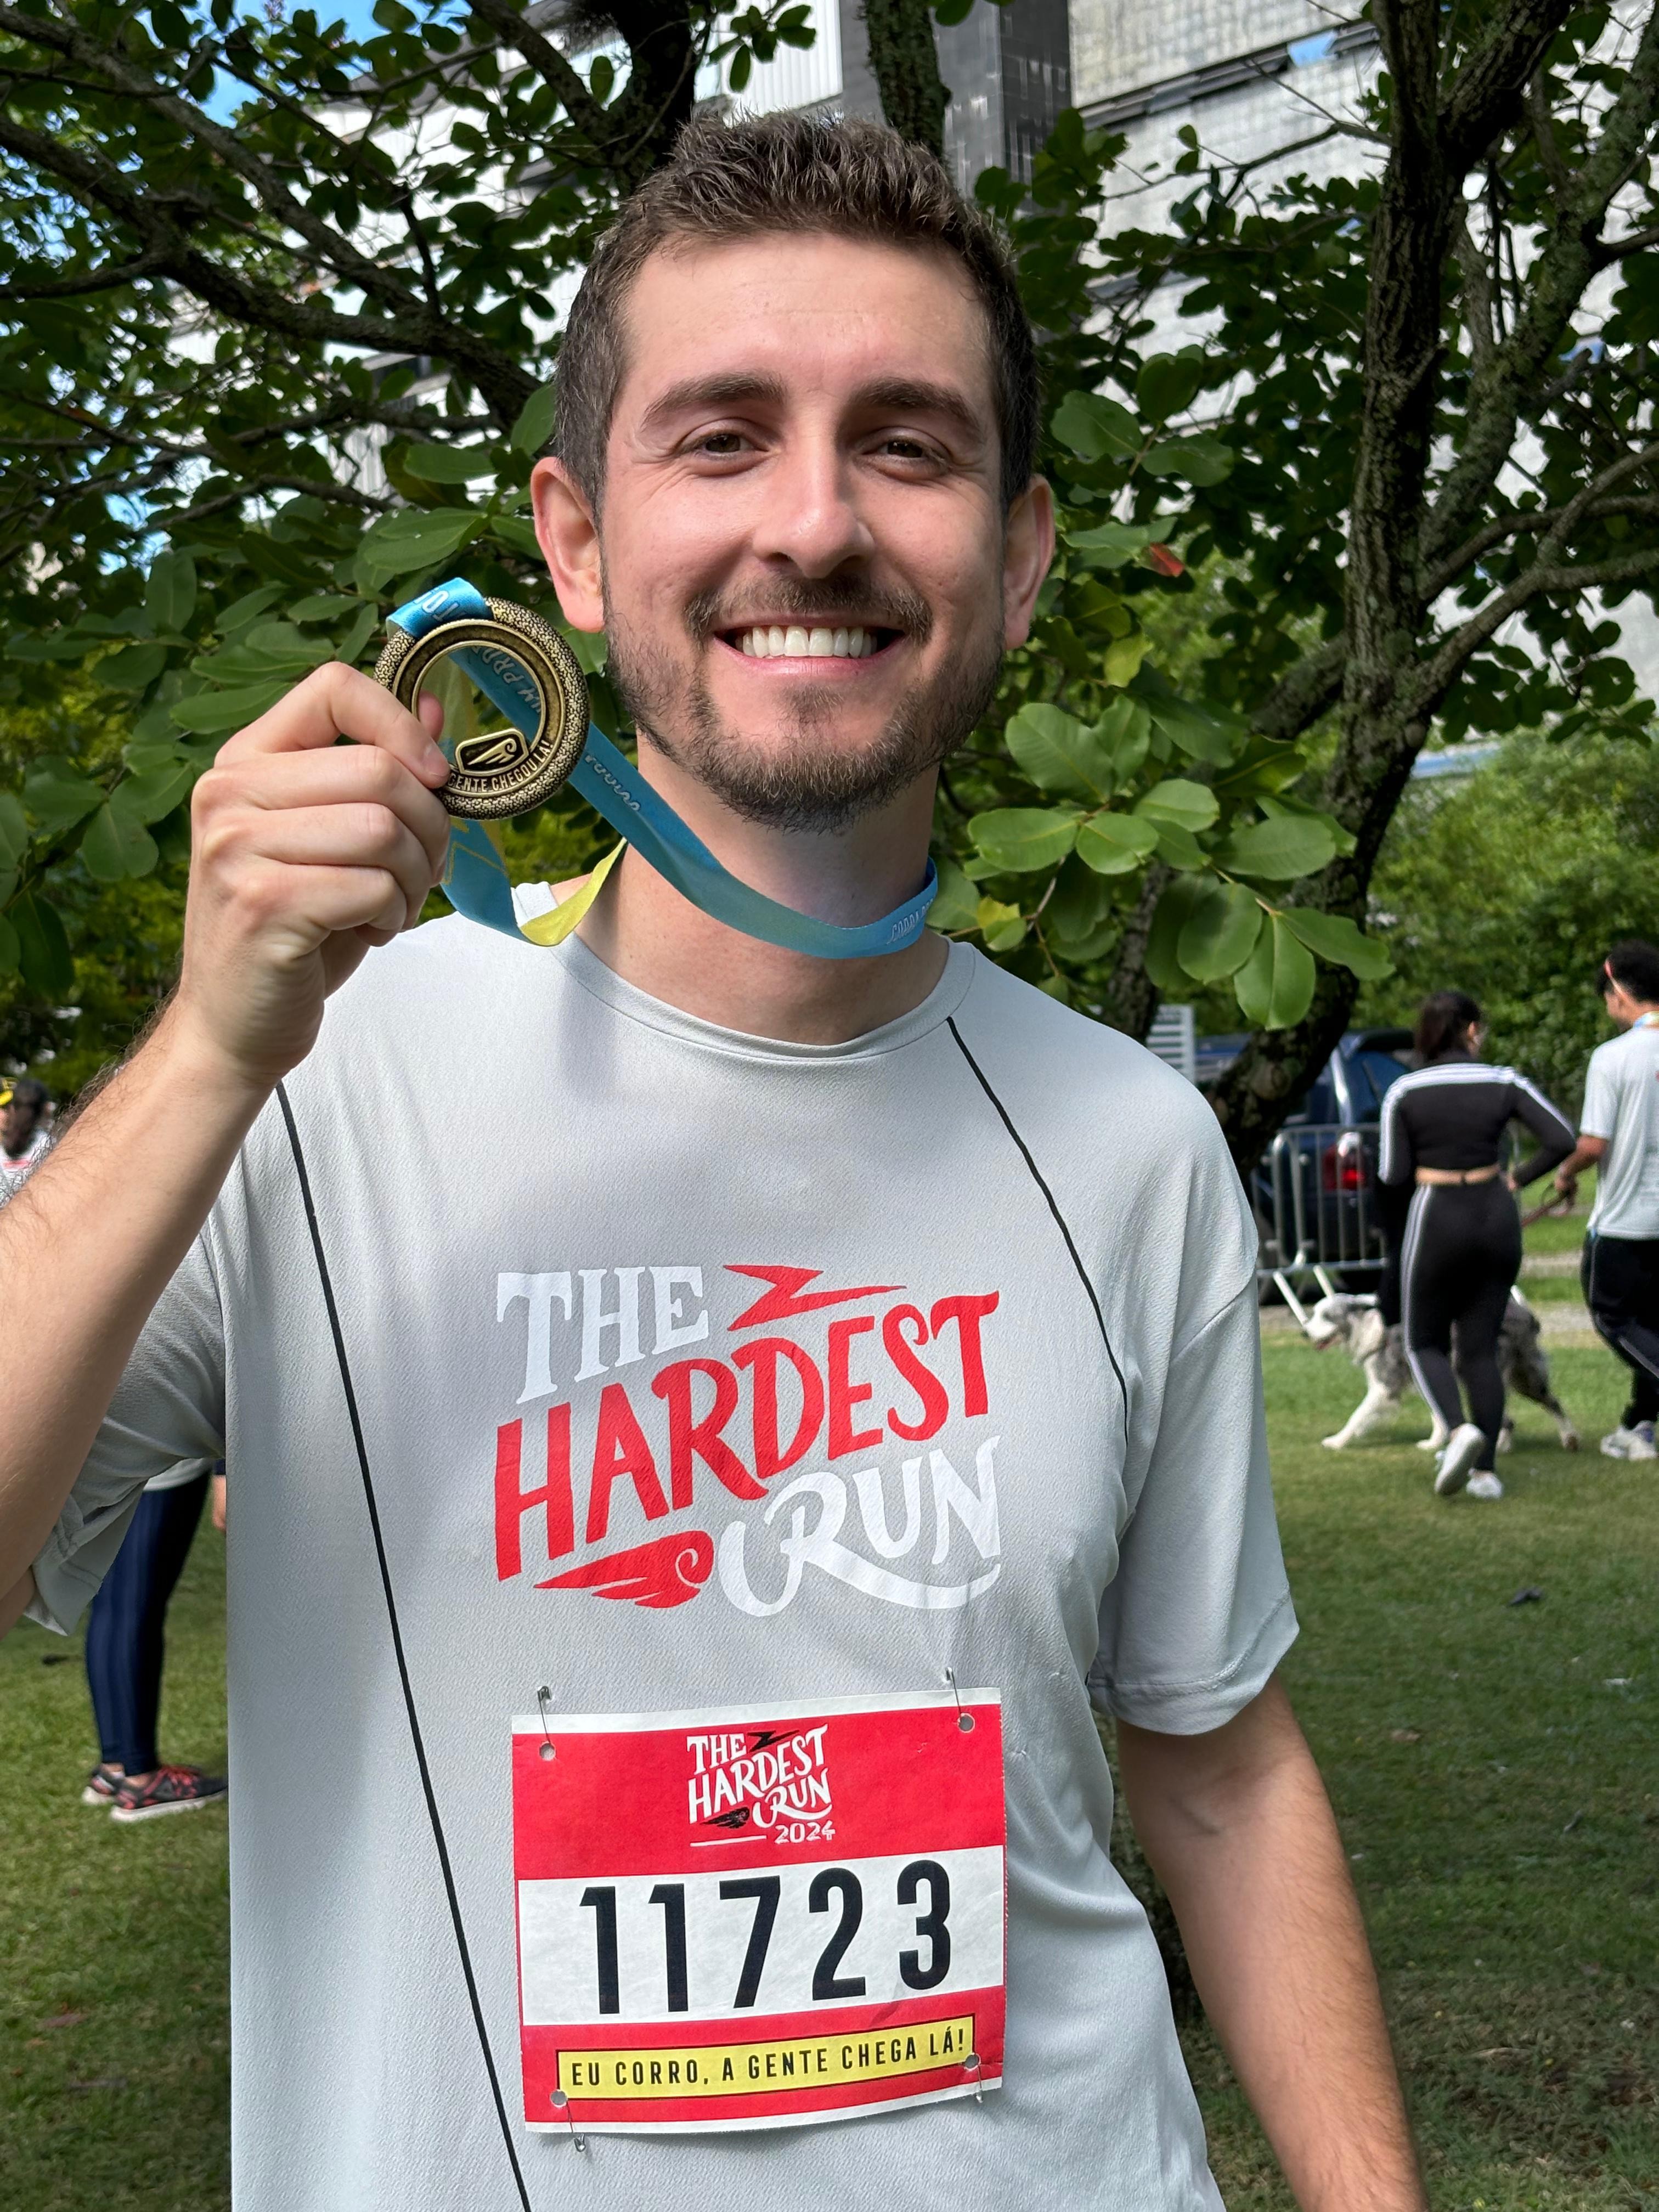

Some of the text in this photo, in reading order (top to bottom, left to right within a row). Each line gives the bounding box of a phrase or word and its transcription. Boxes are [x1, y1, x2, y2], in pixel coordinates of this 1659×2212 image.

[492, 758, 538, 790] CHEGOU
[496, 1266, 709, 1404] THE
[494, 1290, 1000, 1582] HARDEST
[718, 1435, 1002, 1617] RUN
[686, 1733, 747, 1775] THE
[687, 1723, 828, 1824] HARDEST
[752, 1768, 833, 1829] RUN
[774, 1820, 836, 1844] 2024
[579, 1859, 951, 2016] 11723
[572, 2025, 964, 2086] EU CORRO, A GENTE CHEGA LÁ!
